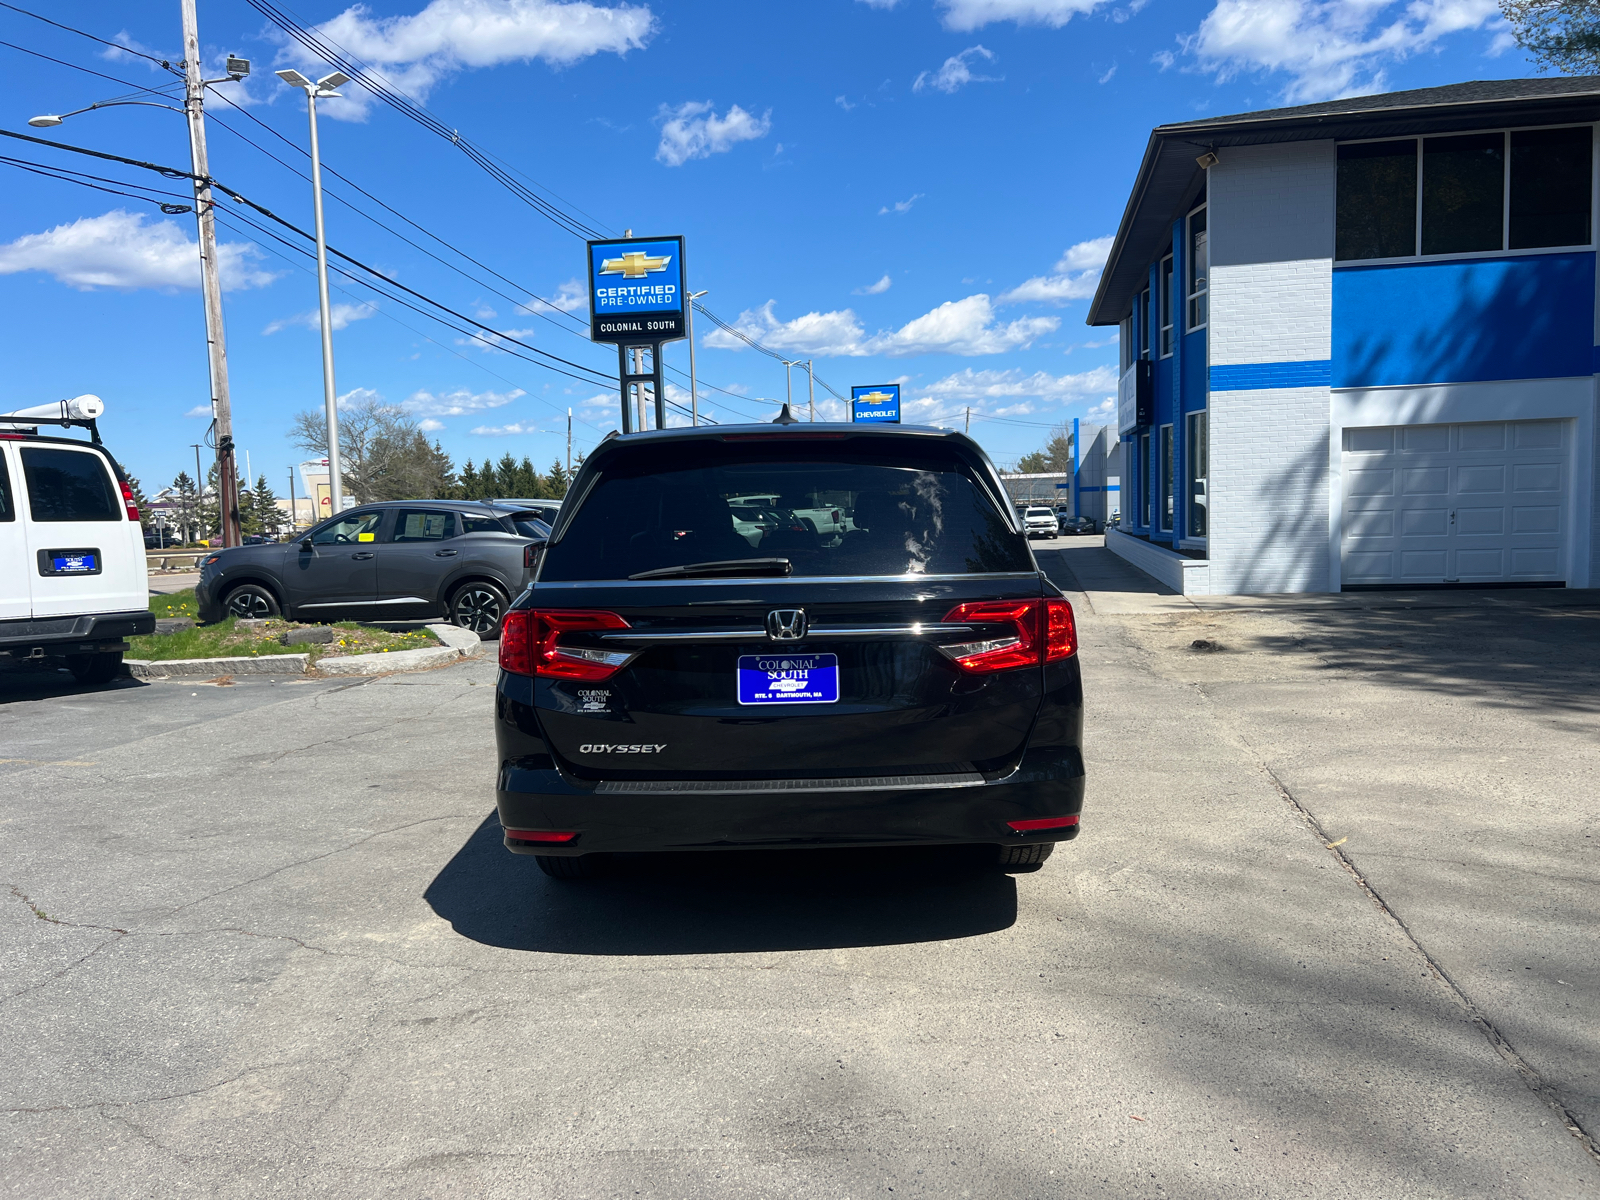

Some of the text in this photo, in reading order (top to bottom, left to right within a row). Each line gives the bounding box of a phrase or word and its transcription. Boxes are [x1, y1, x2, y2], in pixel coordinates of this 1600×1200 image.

[597, 284, 676, 298] CERTIFIED
[601, 294, 672, 306] PRE-OWNED
[600, 320, 675, 332] COLONIAL SOUTH
[856, 410, 896, 418] CHEVROLET
[758, 660, 818, 670] COLONIAL
[767, 669, 809, 680] SOUTH
[579, 744, 667, 753] ODYSSEY
